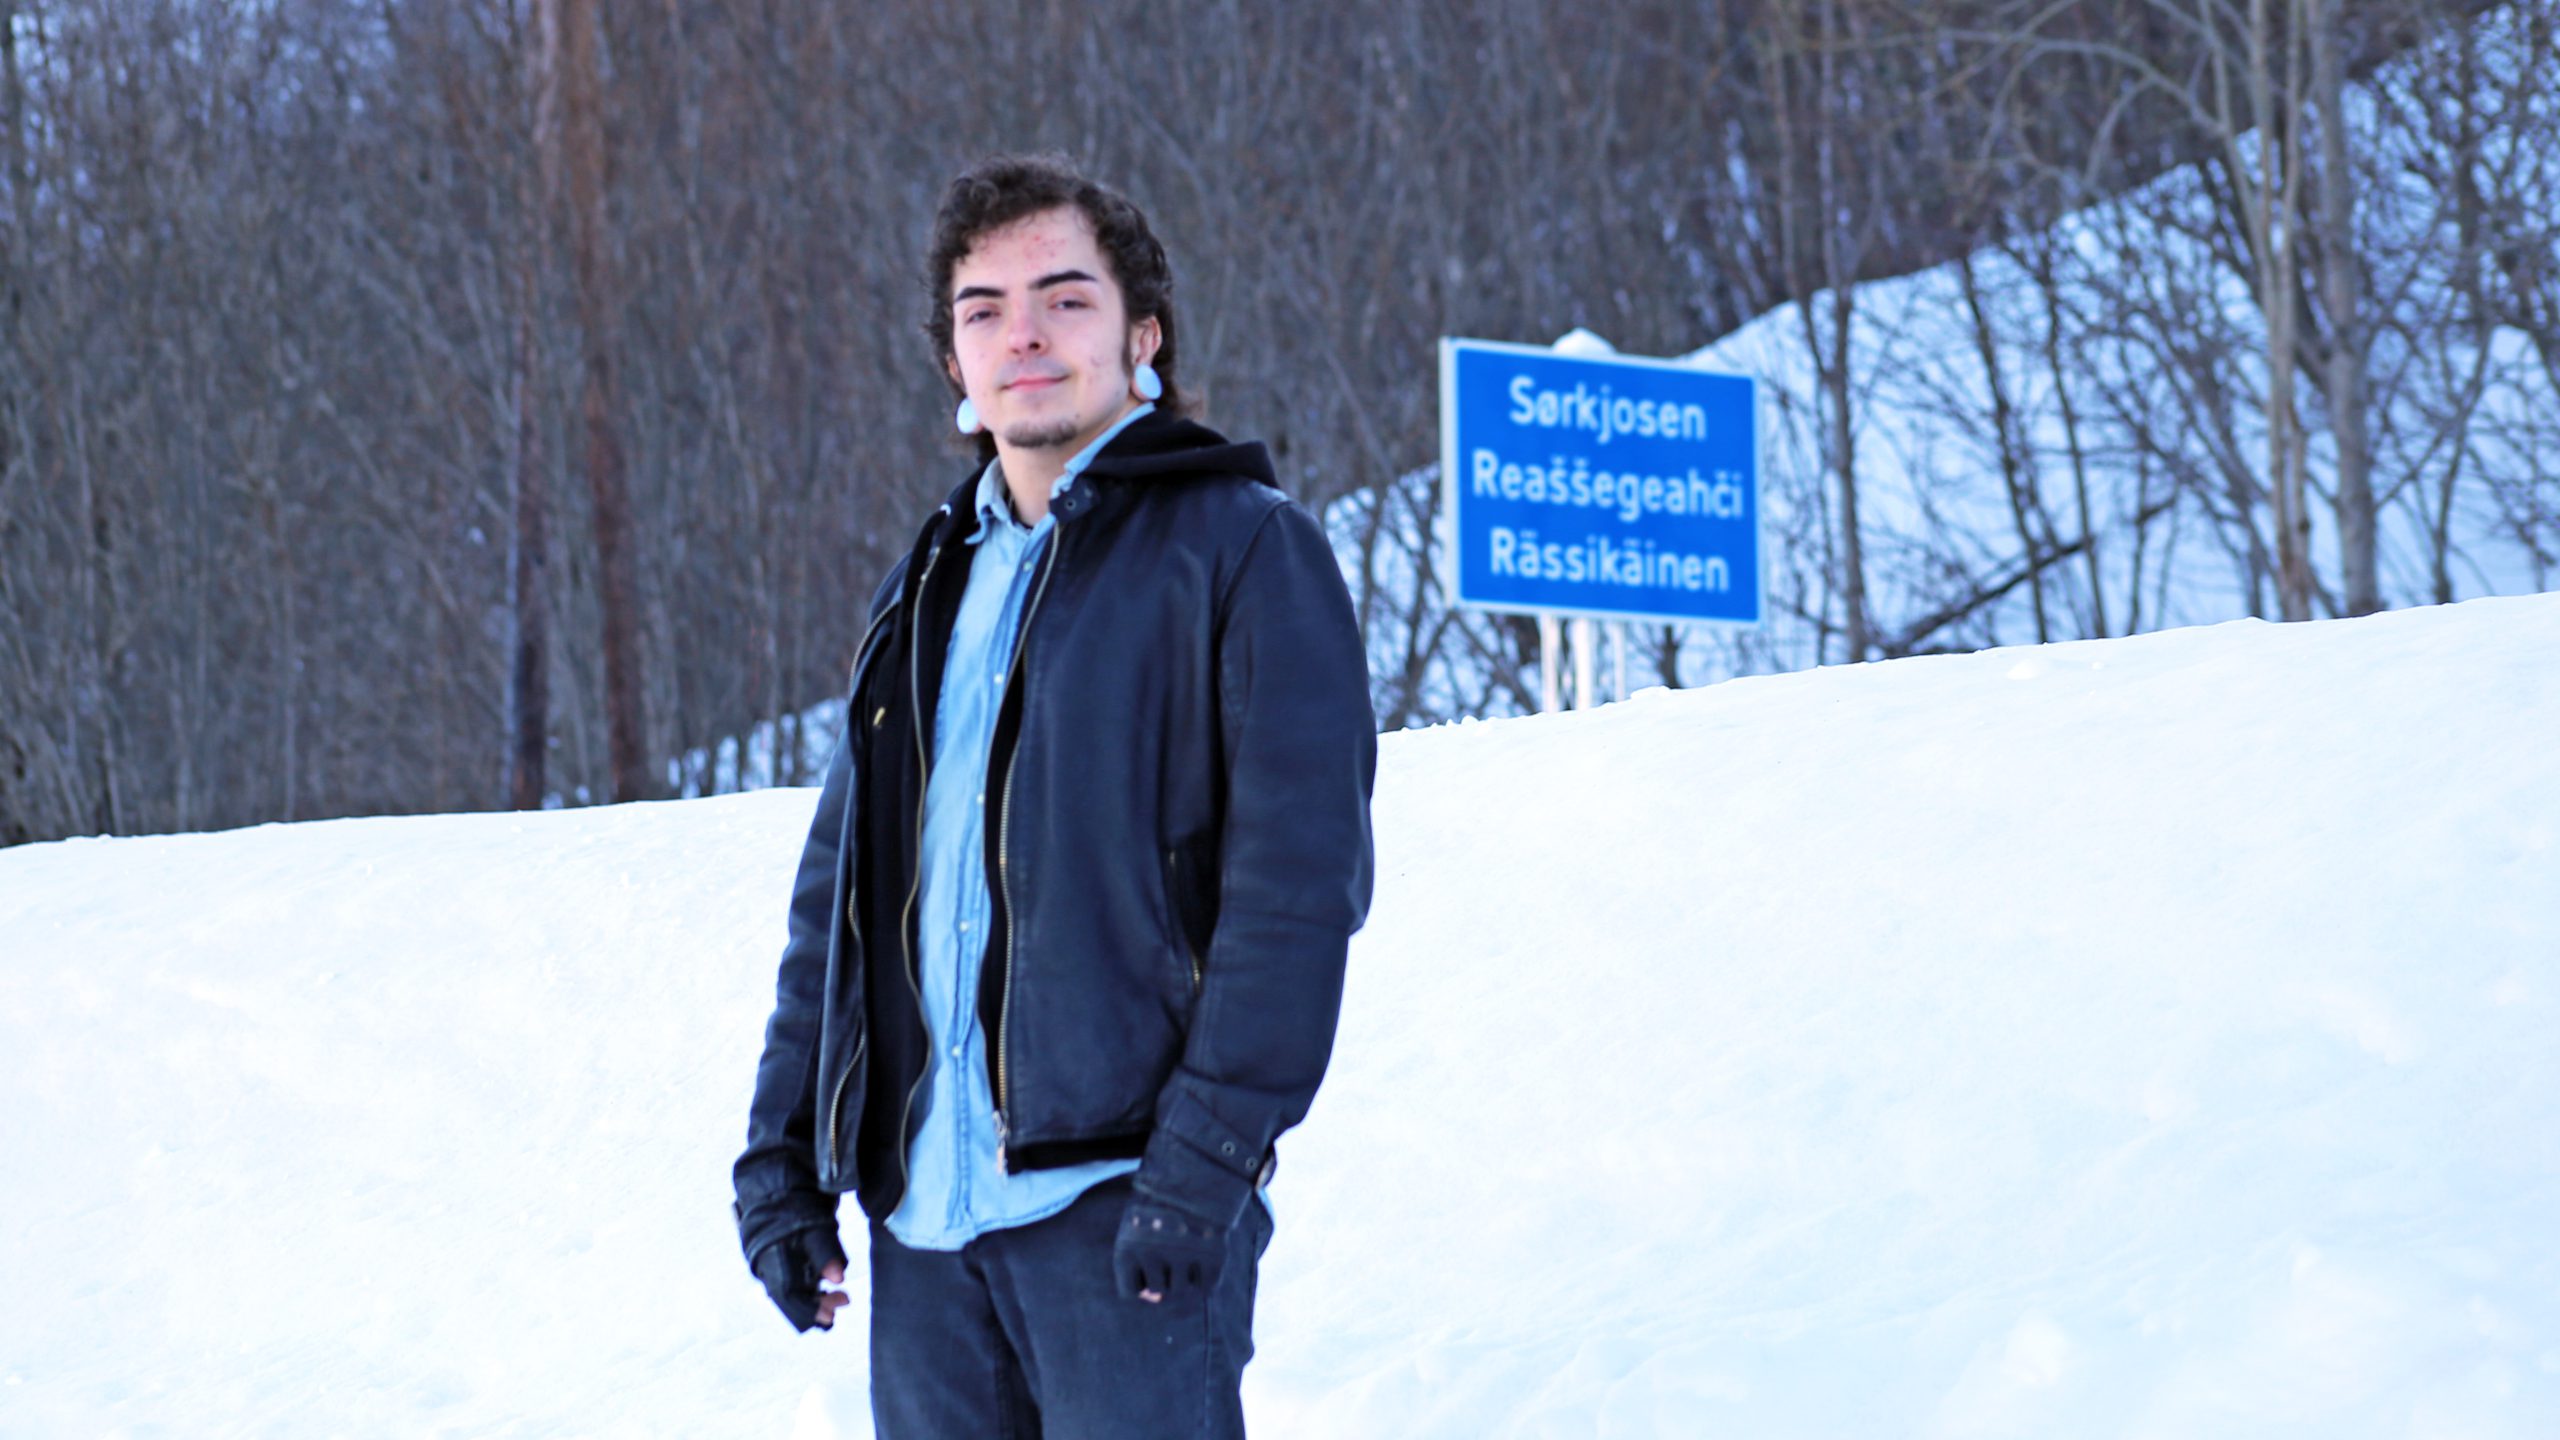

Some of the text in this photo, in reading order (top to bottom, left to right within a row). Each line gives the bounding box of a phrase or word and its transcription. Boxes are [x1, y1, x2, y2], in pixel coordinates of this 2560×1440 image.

[1509, 375, 1707, 444] Sørkjosen
[1472, 449, 1743, 523] Reaššegeahči
[1490, 527, 1730, 592] Rässikäinen
